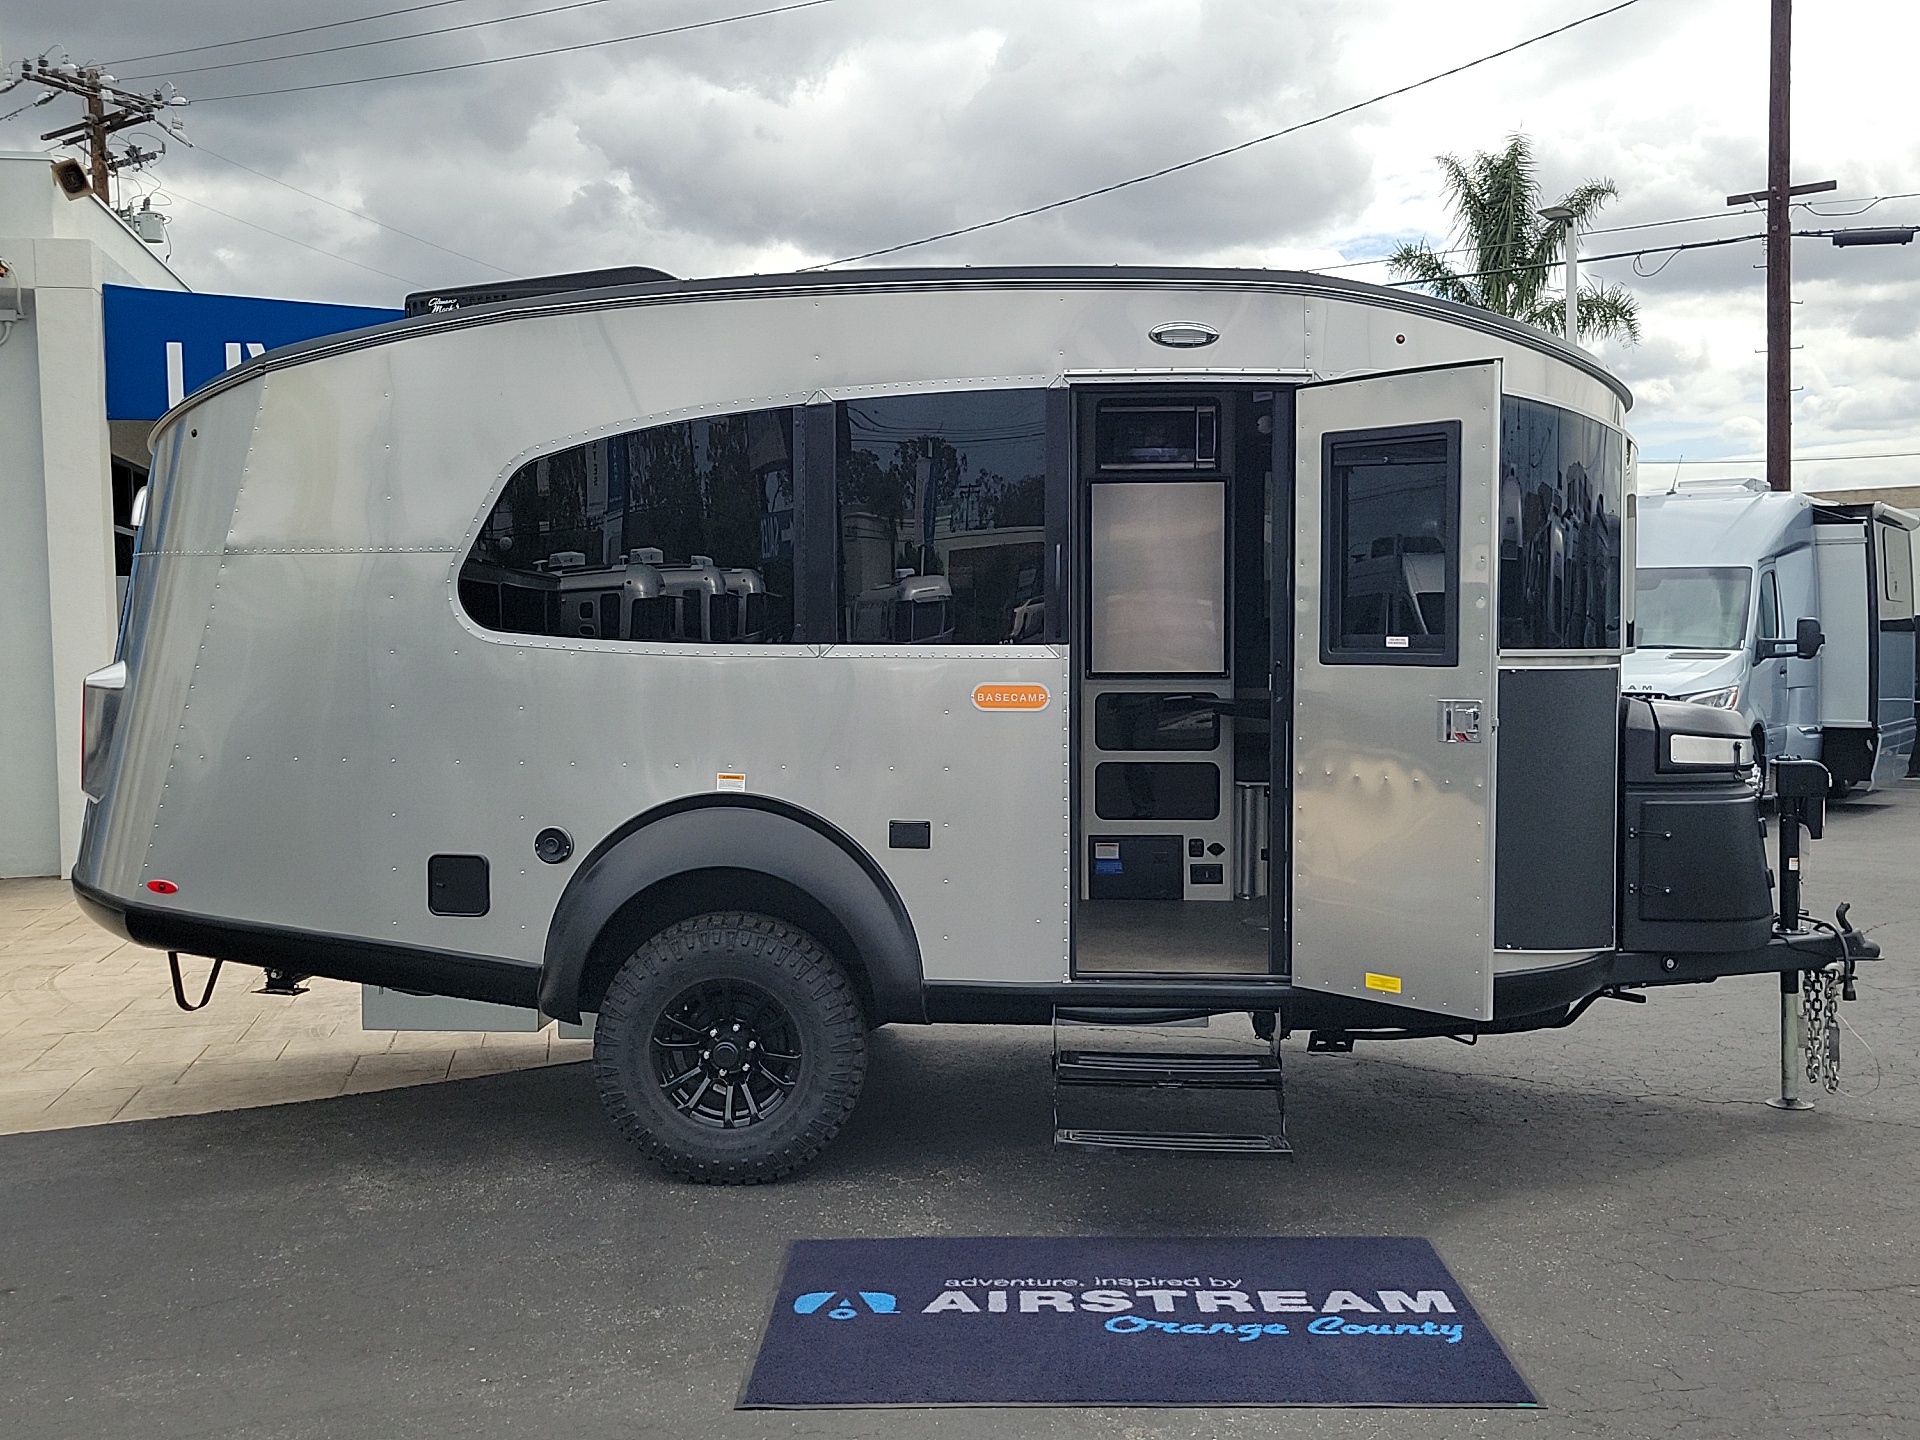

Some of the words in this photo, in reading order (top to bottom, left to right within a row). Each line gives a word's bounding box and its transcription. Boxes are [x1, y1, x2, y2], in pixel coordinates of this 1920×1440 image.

[977, 693, 1046, 702] BASECAMP
[1209, 1276, 1243, 1289] by
[921, 1289, 1457, 1314] AIRSTREAM
[1104, 1315, 1290, 1342] Orange
[1307, 1316, 1464, 1343] County
